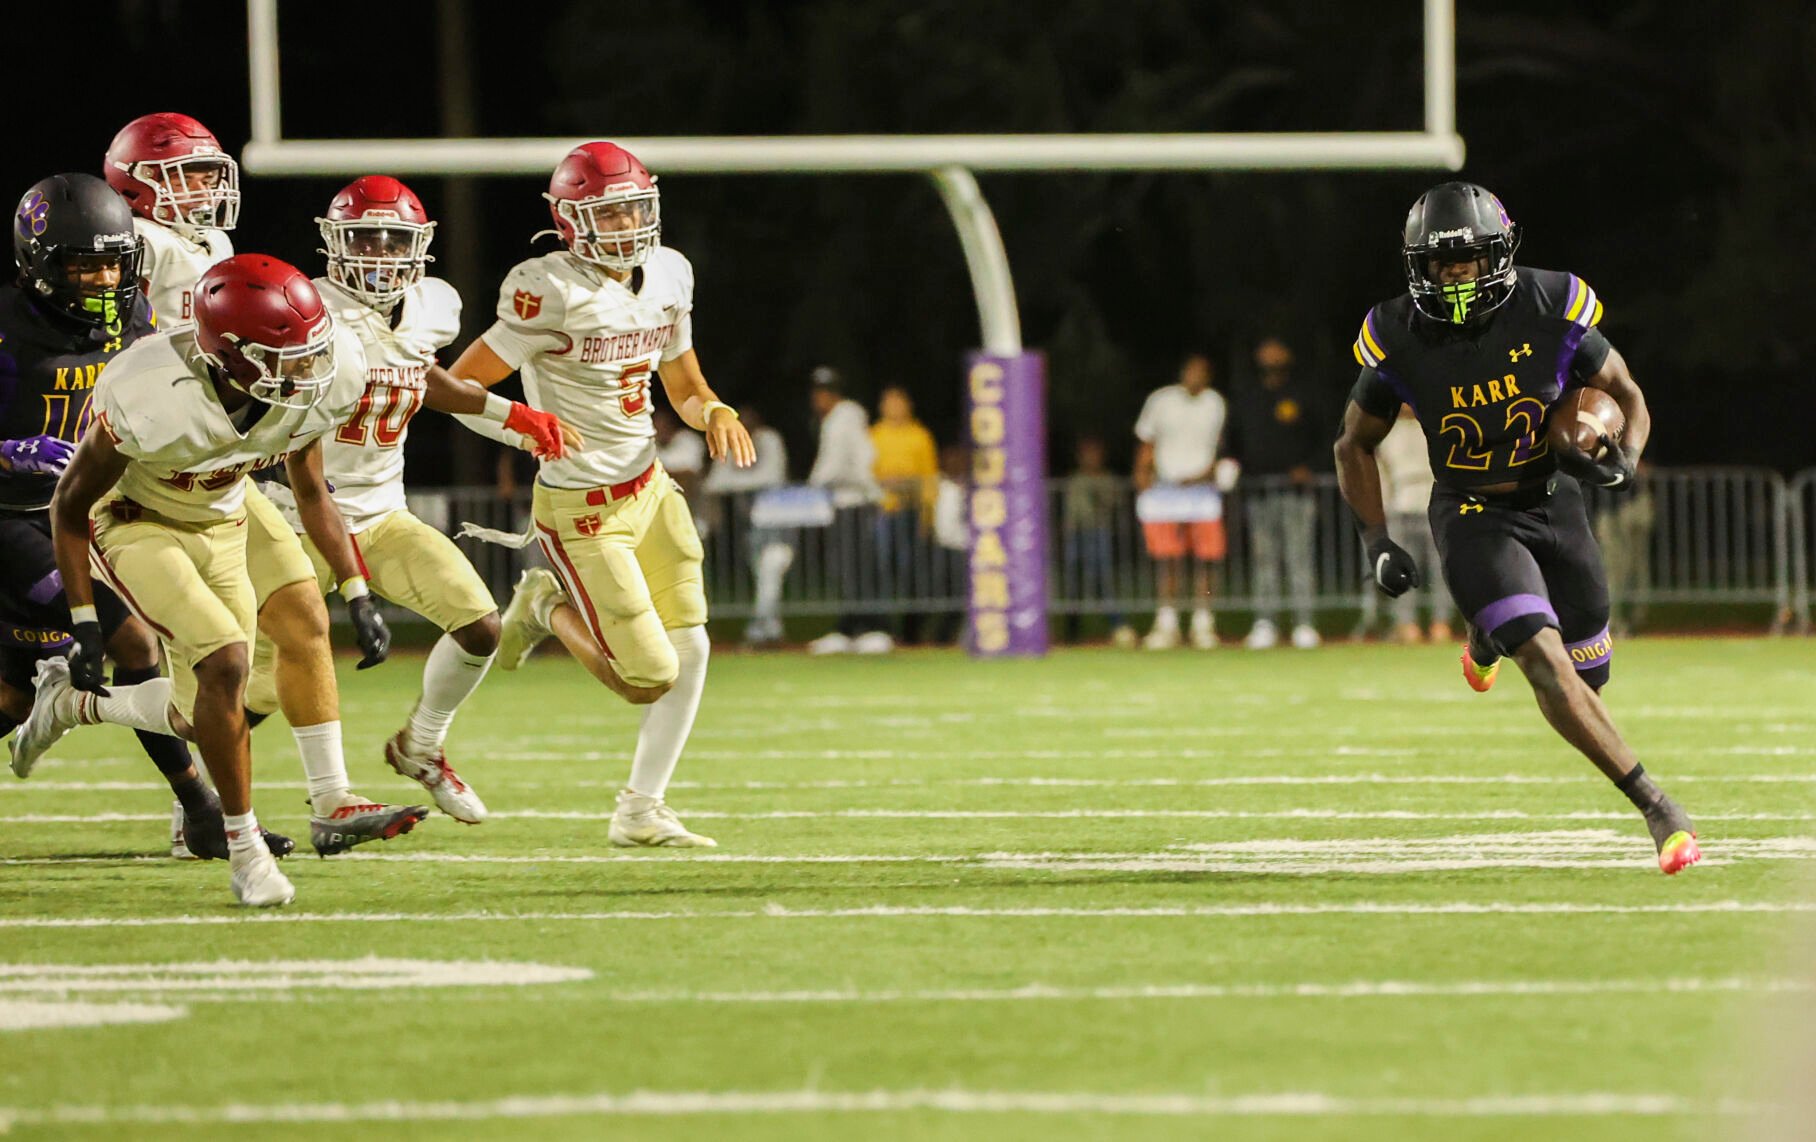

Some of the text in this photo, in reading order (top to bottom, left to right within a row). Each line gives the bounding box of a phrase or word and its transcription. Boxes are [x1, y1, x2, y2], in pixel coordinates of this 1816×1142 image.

[580, 332, 640, 364] BROTHER
[335, 383, 419, 447] 10
[617, 358, 650, 418] 5
[1451, 374, 1520, 408] KARR
[1440, 397, 1549, 470] 22
[970, 362, 1009, 651] COUGARS
